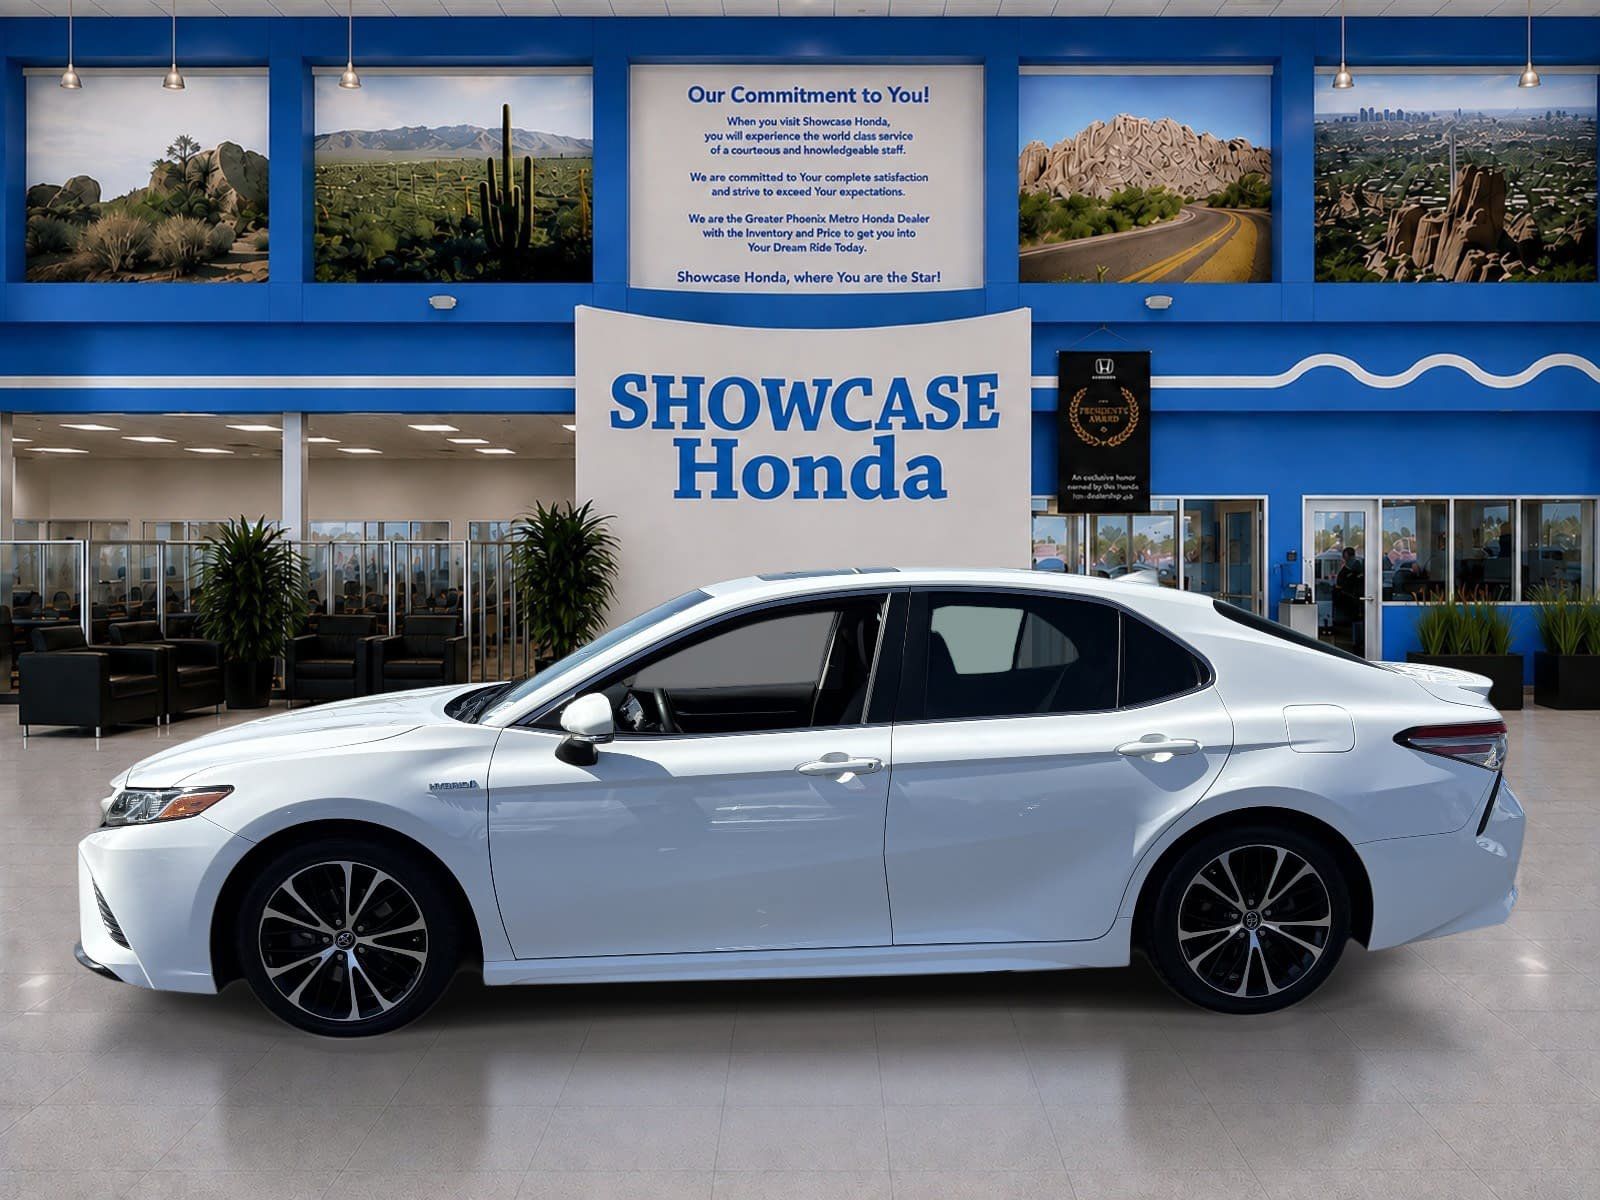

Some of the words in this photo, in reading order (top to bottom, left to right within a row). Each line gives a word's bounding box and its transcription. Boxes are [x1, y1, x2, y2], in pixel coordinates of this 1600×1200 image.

[687, 85, 726, 104] Our
[730, 85, 857, 104] Commitment
[861, 87, 883, 104] to
[886, 85, 930, 104] You!
[726, 116, 757, 127] When
[758, 118, 778, 129] you
[779, 116, 801, 127] visit
[802, 115, 853, 127] Showcase
[854, 116, 891, 128] Honda,
[704, 132, 724, 144] you
[725, 130, 744, 141] will
[744, 130, 801, 144] experience
[802, 130, 820, 141] the
[821, 130, 851, 141] world
[852, 130, 877, 141] class
[878, 130, 914, 142] service
[709, 144, 722, 155] of
[722, 147, 730, 155] a
[730, 146, 782, 156] courteous
[782, 144, 802, 155] and
[689, 172, 708, 183] We
[709, 174, 727, 182] are
[728, 171, 784, 183] committed
[785, 173, 798, 183] to
[799, 172, 823, 183] Your
[824, 172, 872, 185] complete
[873, 171, 929, 183] satisfaction
[711, 186, 731, 197] and
[732, 186, 761, 197] strive
[762, 187, 774, 197] to
[775, 186, 812, 197] exceed
[814, 186, 838, 197] Your
[838, 186, 906, 200] expectations.
[688, 213, 706, 224] We
[707, 215, 725, 224] are
[725, 213, 743, 224] the
[744, 213, 785, 224] Greater
[785, 213, 827, 224] Phoenix
[828, 213, 860, 224] Metro
[861, 213, 895, 224] Honda
[897, 213, 931, 224] Dealer
[702, 227, 725, 238] with
[726, 227, 744, 238] the
[745, 227, 794, 241] Inventory
[795, 227, 815, 239] and
[816, 227, 842, 239] Price
[843, 229, 855, 238] to
[856, 229, 875, 241] get
[876, 230, 895, 241] you
[896, 227, 917, 239] into
[747, 242, 772, 253] Your
[773, 242, 808, 253] Dream
[809, 242, 833, 253] Ride
[833, 242, 868, 255] Today.
[677, 270, 741, 284] Showcase
[744, 270, 790, 286] Honda,
[793, 270, 834, 284] where
[836, 271, 861, 284] You
[863, 274, 884, 284] are
[886, 270, 908, 284] the
[911, 271, 941, 284] Star!
[609, 372, 1001, 432] SHOWCASE
[672, 433, 949, 501] Honda
